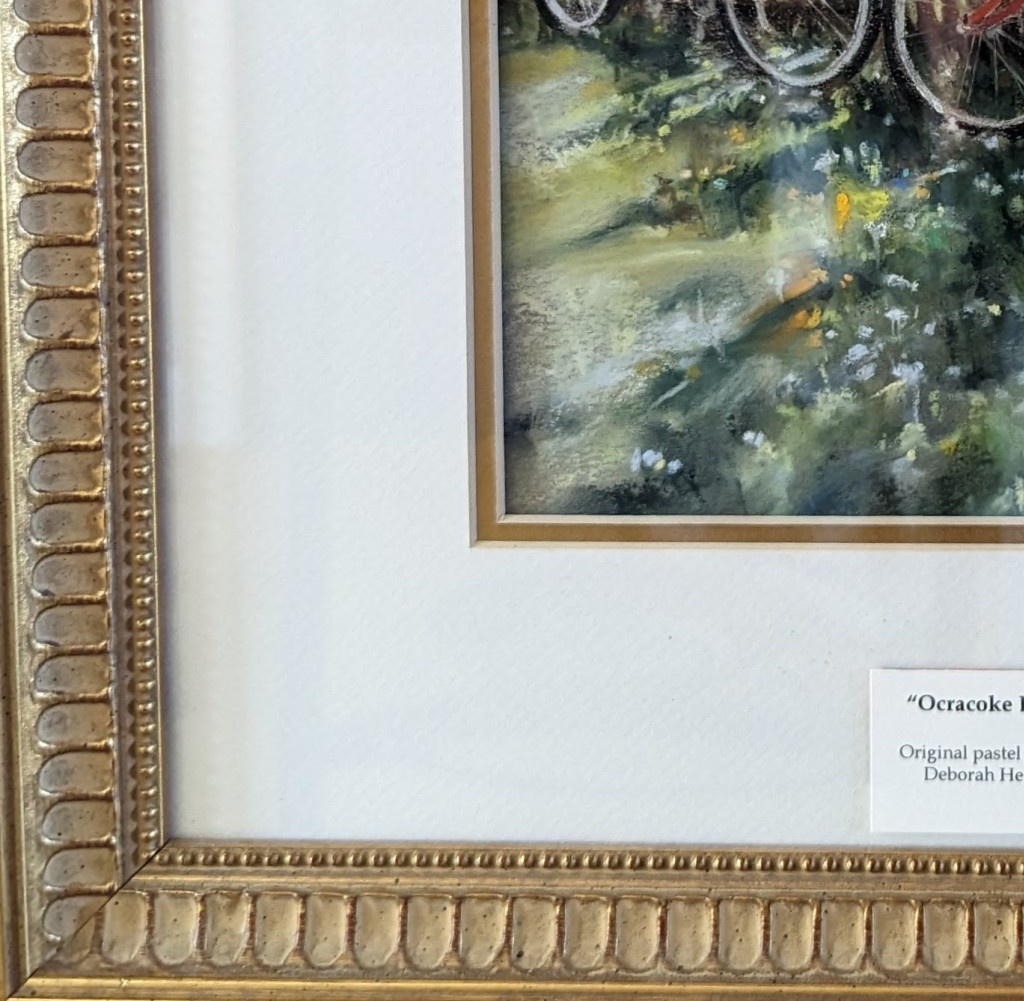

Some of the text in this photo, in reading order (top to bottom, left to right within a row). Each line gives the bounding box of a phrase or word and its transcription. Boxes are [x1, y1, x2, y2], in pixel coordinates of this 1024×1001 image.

[907, 694, 1012, 712] “Ocracoke
[899, 744, 967, 763] Original
[973, 745, 1021, 764] pastel
[924, 766, 995, 782] Deborah
